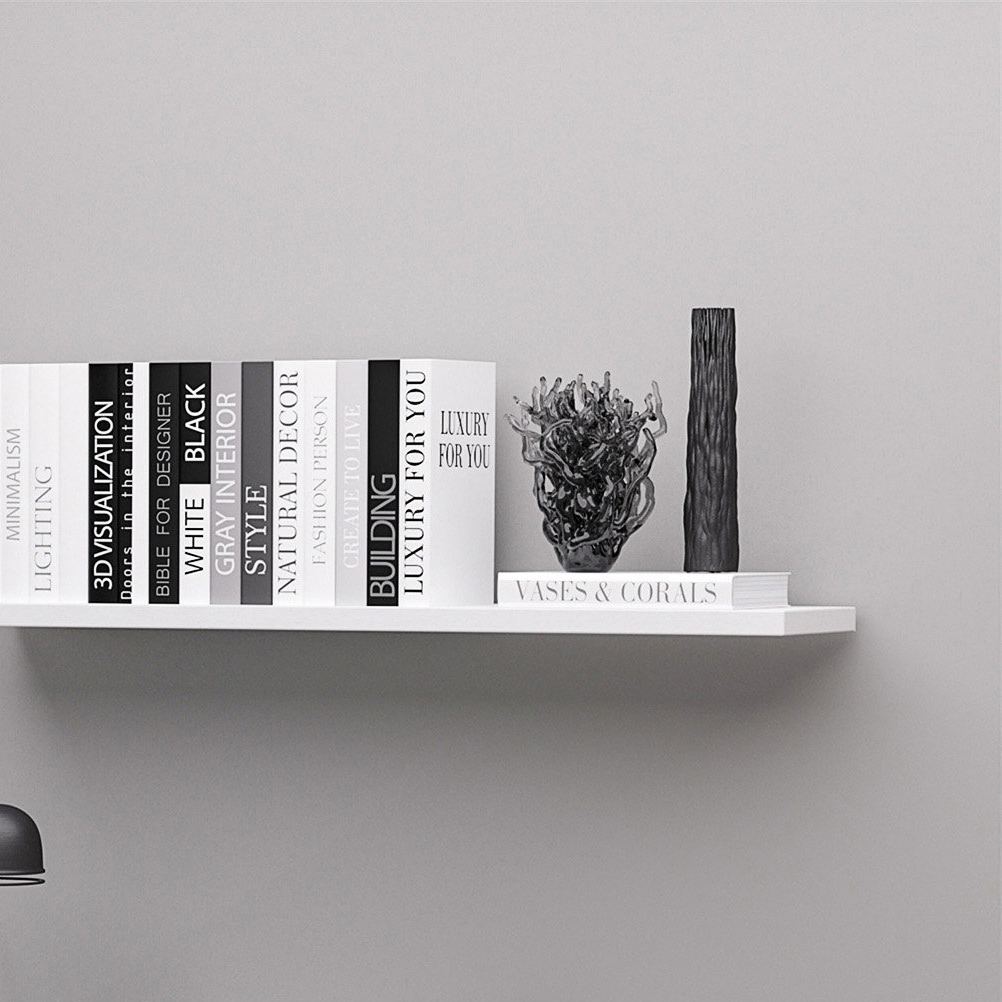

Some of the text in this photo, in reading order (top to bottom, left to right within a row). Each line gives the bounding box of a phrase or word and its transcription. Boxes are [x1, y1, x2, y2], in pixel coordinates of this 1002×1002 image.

[6, 428, 21, 541] MINIMALISM
[121, 368, 134, 600] Doors in the interior
[185, 383, 206, 462] BLACK
[215, 392, 236, 576] GRAY INTERIOR
[278, 371, 298, 595] NATURAL DECOR
[313, 395, 328, 566] FASHION PERSON
[404, 370, 426, 595] LUXURY FOR YOU
[438, 443, 491, 469] FOR YOU
[440, 410, 489, 437] LUXURY
[34, 465, 52, 592] LIGHTING
[94, 401, 114, 590] 3D VISUALIZATION
[156, 392, 171, 597] BIBLE FOR DESIGNER
[185, 498, 204, 576] WHITE
[244, 485, 267, 575] STYLE
[343, 404, 361, 569] CREATE TO LIVE
[370, 473, 397, 598] BUILDING
[516, 580, 718, 604] VASES & CORALS
